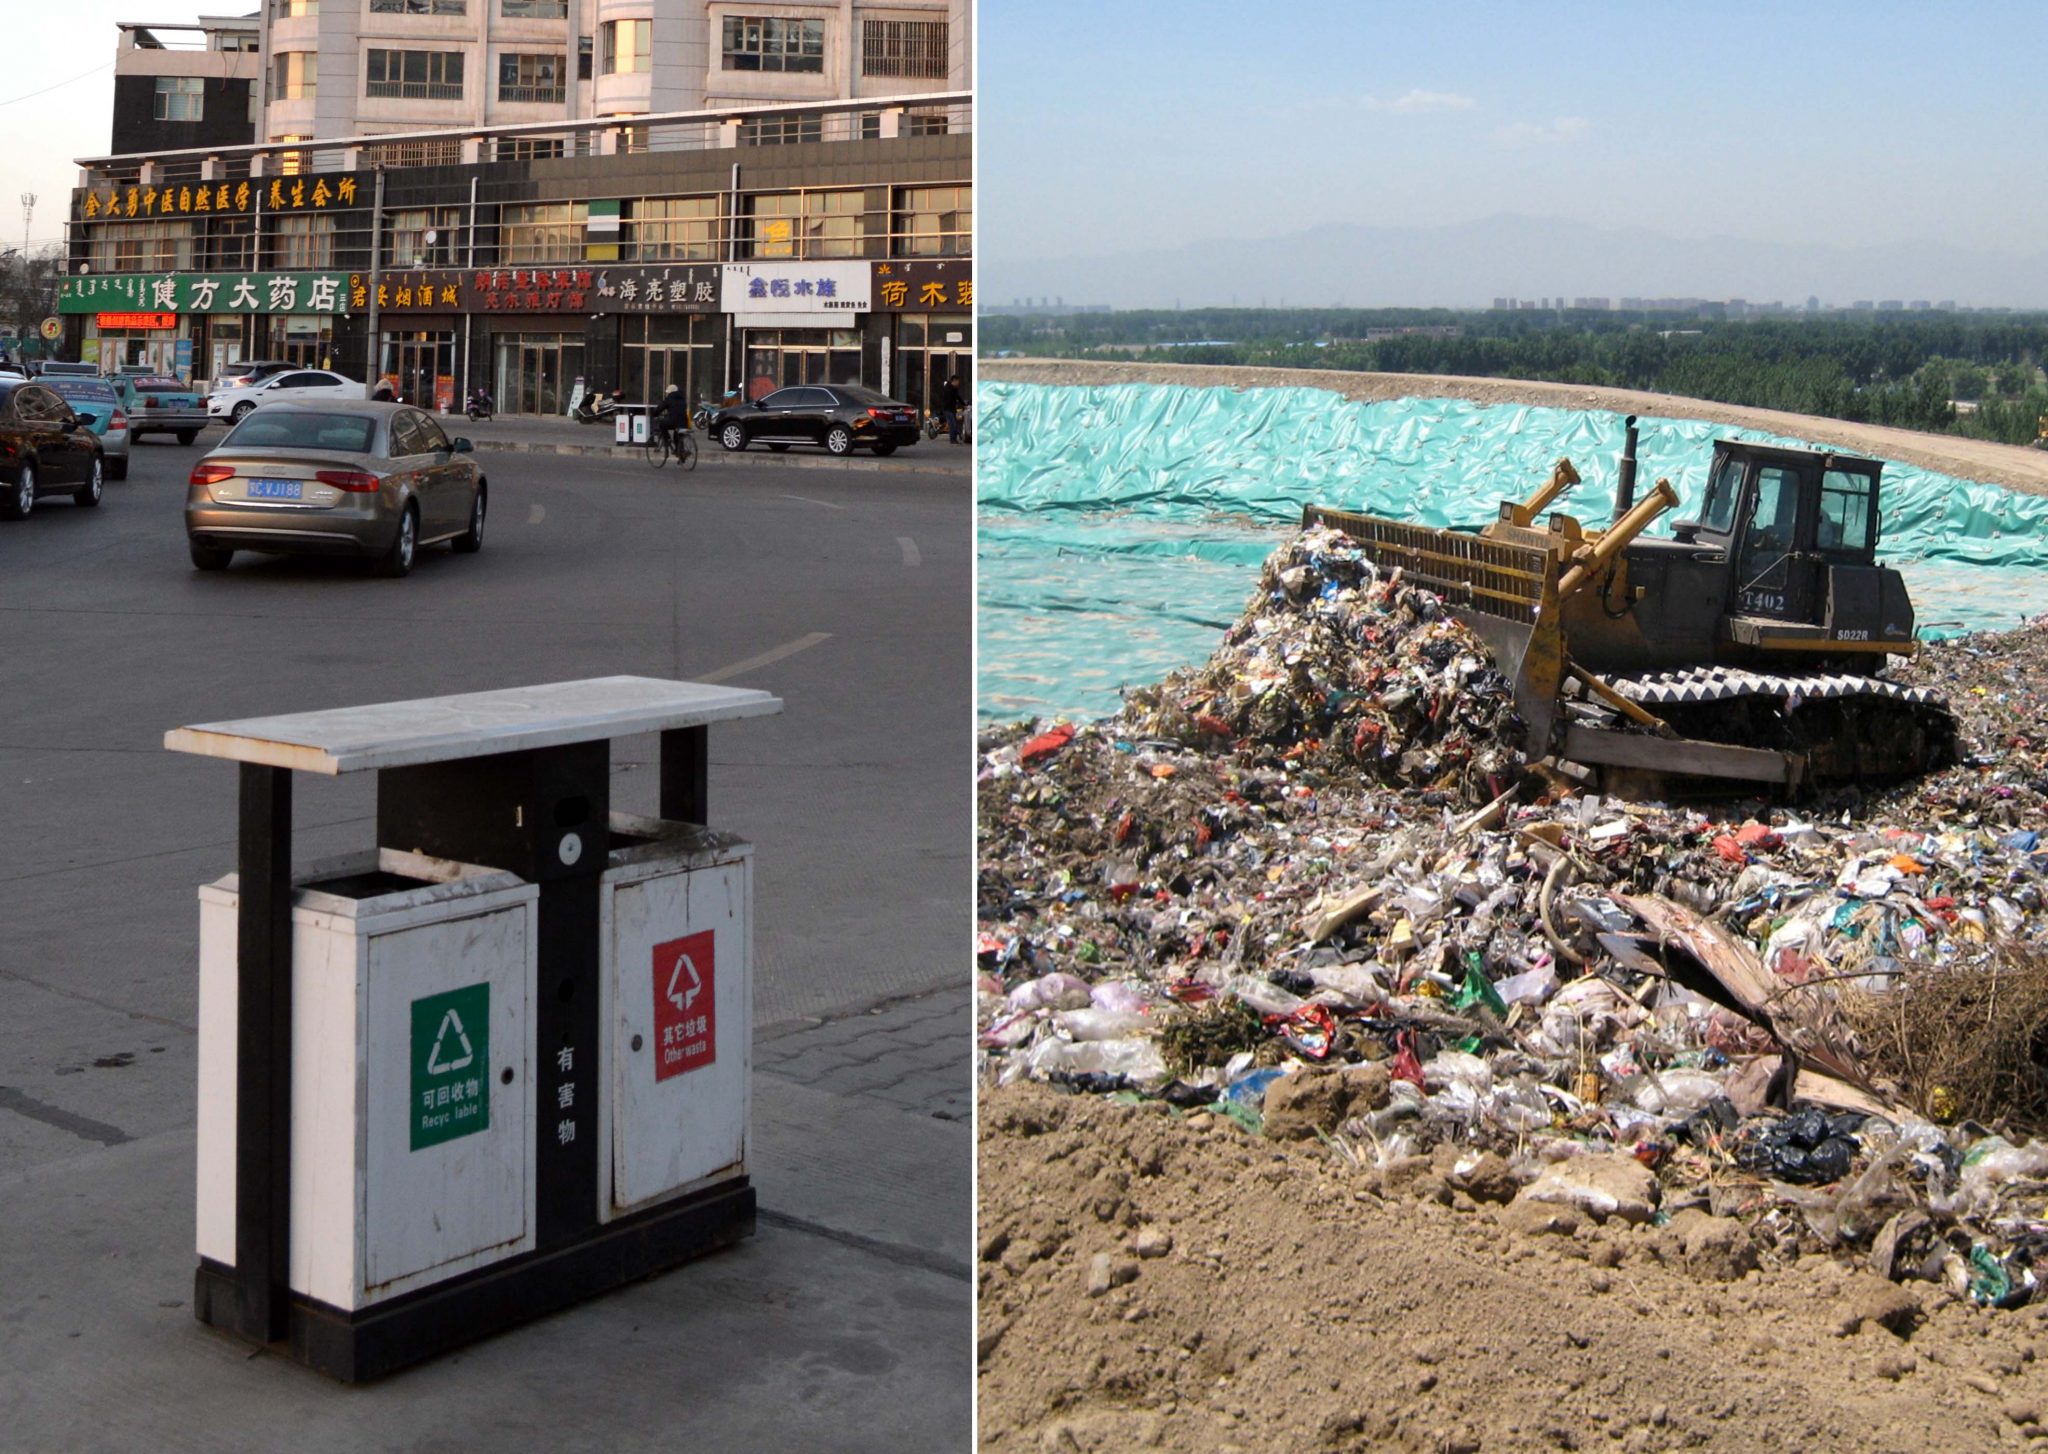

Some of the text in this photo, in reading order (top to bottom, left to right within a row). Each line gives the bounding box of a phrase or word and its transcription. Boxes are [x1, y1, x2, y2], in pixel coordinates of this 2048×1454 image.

[267, 177, 358, 210] 养生会所
[152, 275, 340, 312] 健方大药店
[619, 278, 716, 302] 海亮塑胶
[1837, 629, 1869, 641] SD22R
[663, 1015, 708, 1046] 其它垃圾
[664, 1047, 685, 1065] Other
[422, 1078, 479, 1110] 可回收物
[557, 1046, 576, 1145] 有害物
